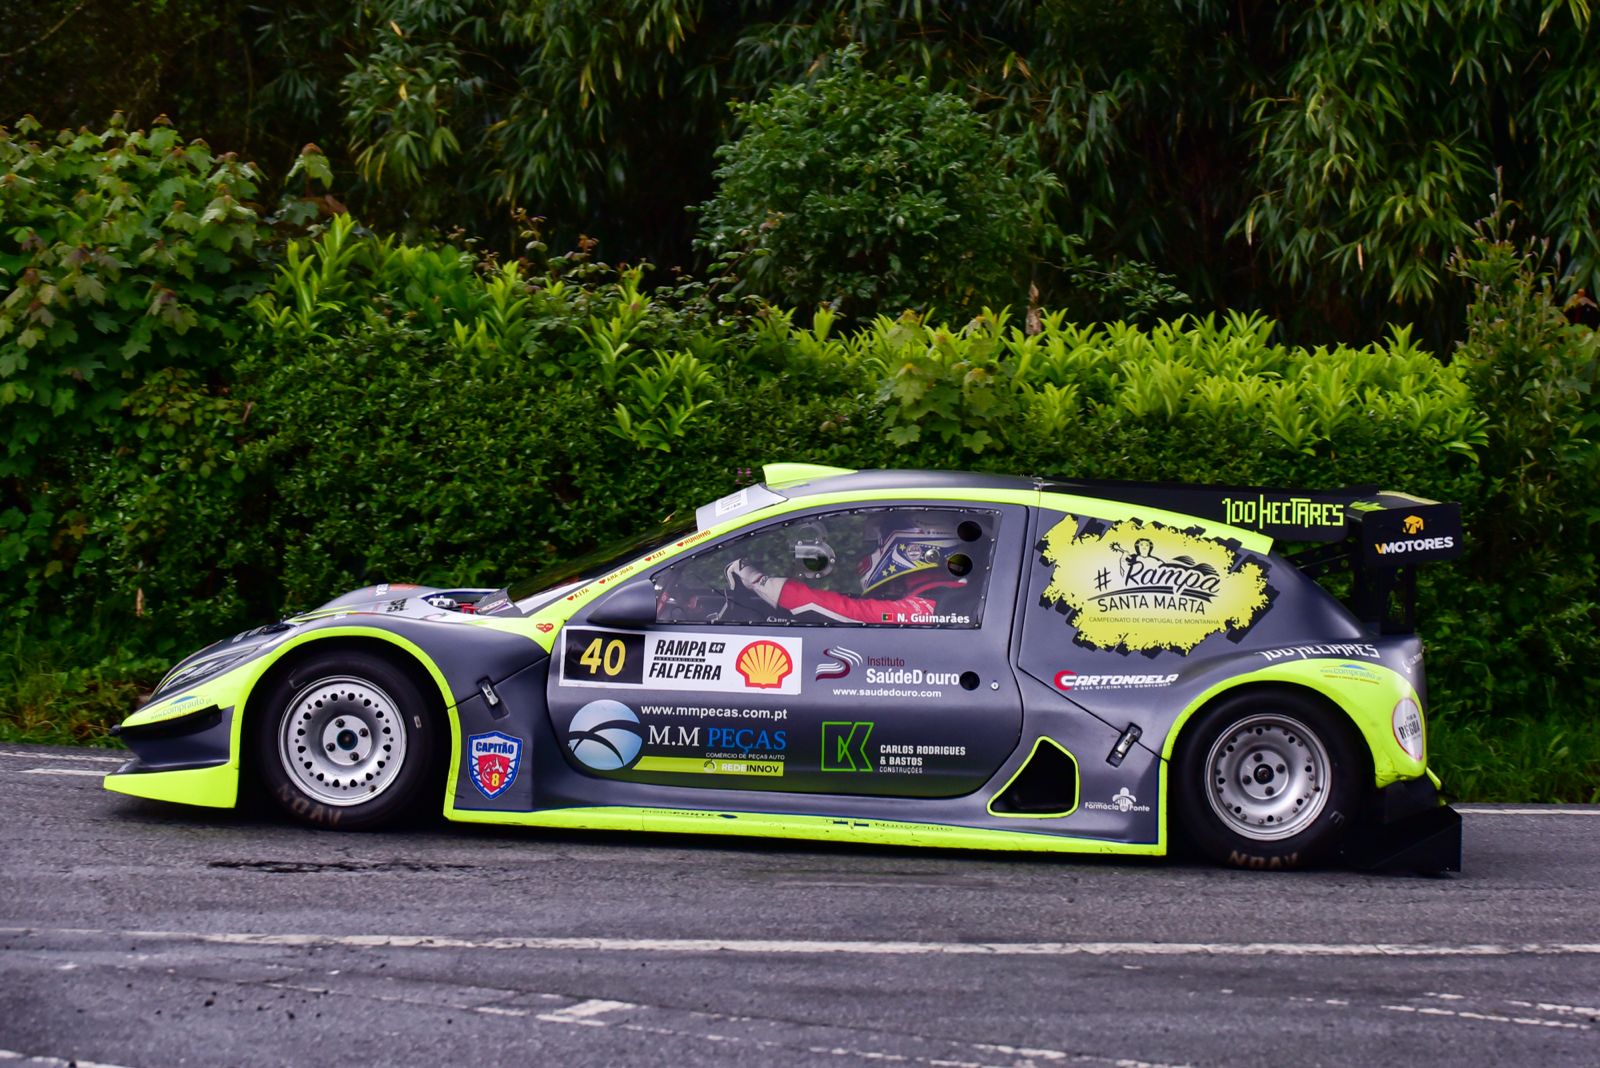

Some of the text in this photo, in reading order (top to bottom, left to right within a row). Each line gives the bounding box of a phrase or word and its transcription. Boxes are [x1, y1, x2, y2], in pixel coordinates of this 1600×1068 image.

[1222, 494, 1344, 529] 100 HECTARES
[1094, 561, 1221, 593] # Rampa
[1097, 595, 1205, 615] SANTA MARTA
[897, 613, 970, 624] N. Guimarães
[655, 639, 707, 657] RAMPA
[580, 637, 626, 676] 40
[867, 656, 905, 668] Instituto
[648, 662, 722, 680] FALPERRA
[1060, 673, 1179, 686] CARTONDELA
[832, 688, 942, 698] www.saudedouro.com
[640, 705, 788, 720] www.mmpecas.com.pt
[648, 724, 788, 754] M.M PEÇAS
[475, 741, 515, 755] CAPITÃO
[880, 744, 966, 756] CARLOS RODRIGUES
[879, 756, 923, 766] & BASTOS
[879, 765, 923, 774] CONSTRUÇÕES
[490, 774, 500, 787] 8
